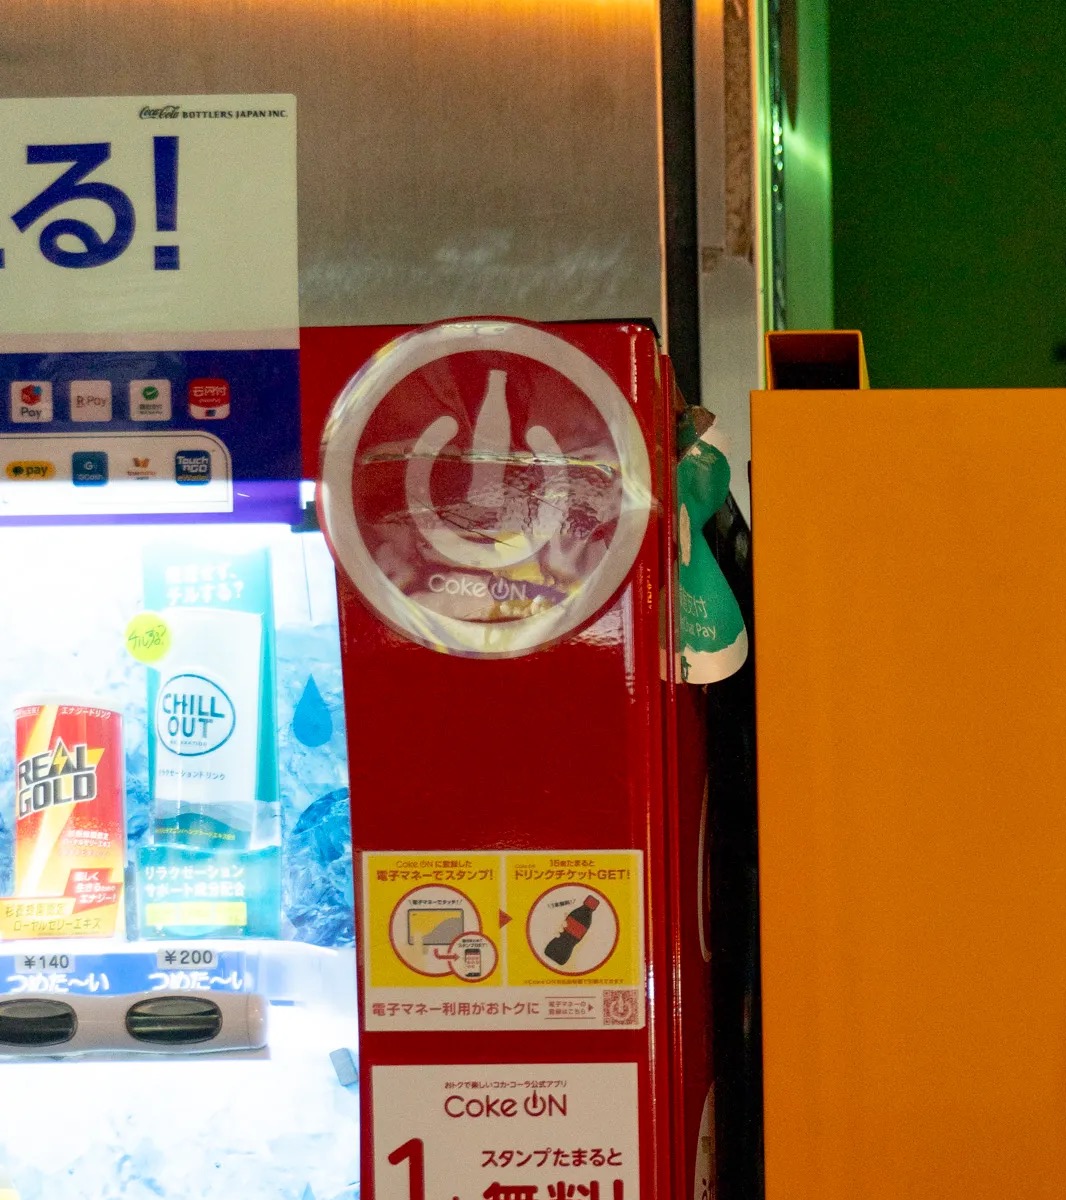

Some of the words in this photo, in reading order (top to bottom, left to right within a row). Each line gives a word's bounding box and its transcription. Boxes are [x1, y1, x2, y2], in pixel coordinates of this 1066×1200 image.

[182, 110, 234, 119] BOTTLERS
[235, 110, 267, 119] JAPAN
[268, 109, 289, 118] INC.
[0, 135, 180, 269] る!
[21, 407, 43, 419] Pay
[26, 464, 48, 479] pay
[428, 574, 487, 596] Coke
[696, 622, 717, 640] Pay
[162, 693, 225, 719] CHILL
[167, 717, 214, 738] OUT
[18, 736, 96, 789] REAL
[18, 771, 97, 819] GOLD
[376, 869, 494, 881] 電子マネーでスタンプ!
[514, 869, 631, 881] ドリンクチケットGET!
[24, 955, 70, 969] ¥140
[164, 950, 213, 965] ¥200
[372, 1002, 540, 1016] 電子マネー利用がおトクに
[444, 1094, 518, 1118] Coke
[524, 1089, 567, 1117] ON
[481, 1147, 623, 1168] スタンプたまると
